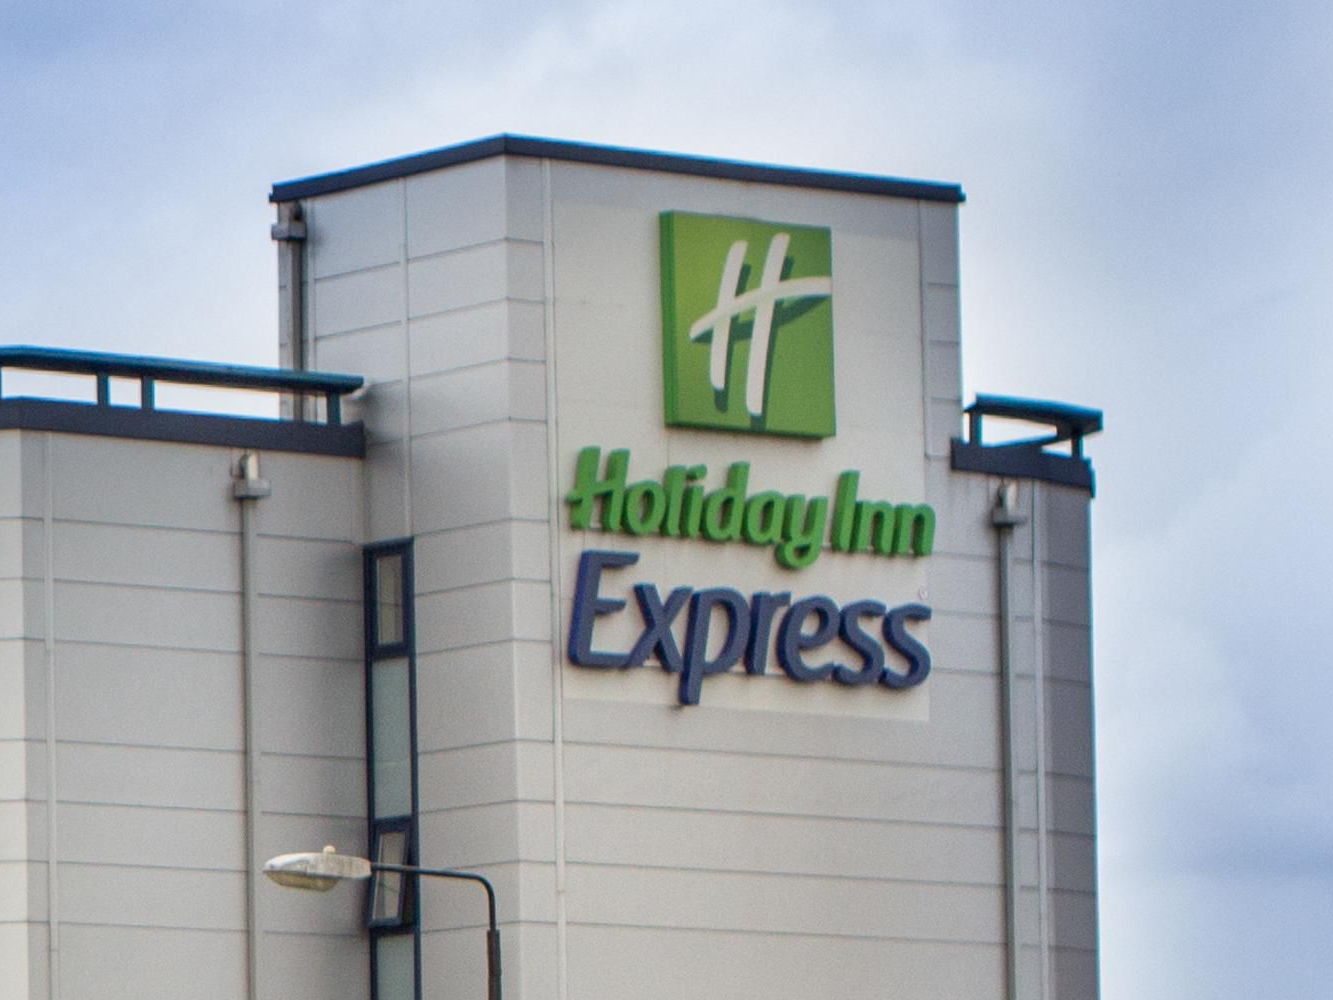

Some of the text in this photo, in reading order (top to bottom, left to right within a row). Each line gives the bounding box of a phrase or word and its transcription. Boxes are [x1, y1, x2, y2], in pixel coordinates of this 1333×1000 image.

[566, 446, 935, 569] Holiday Inn
[568, 550, 933, 705] Express
